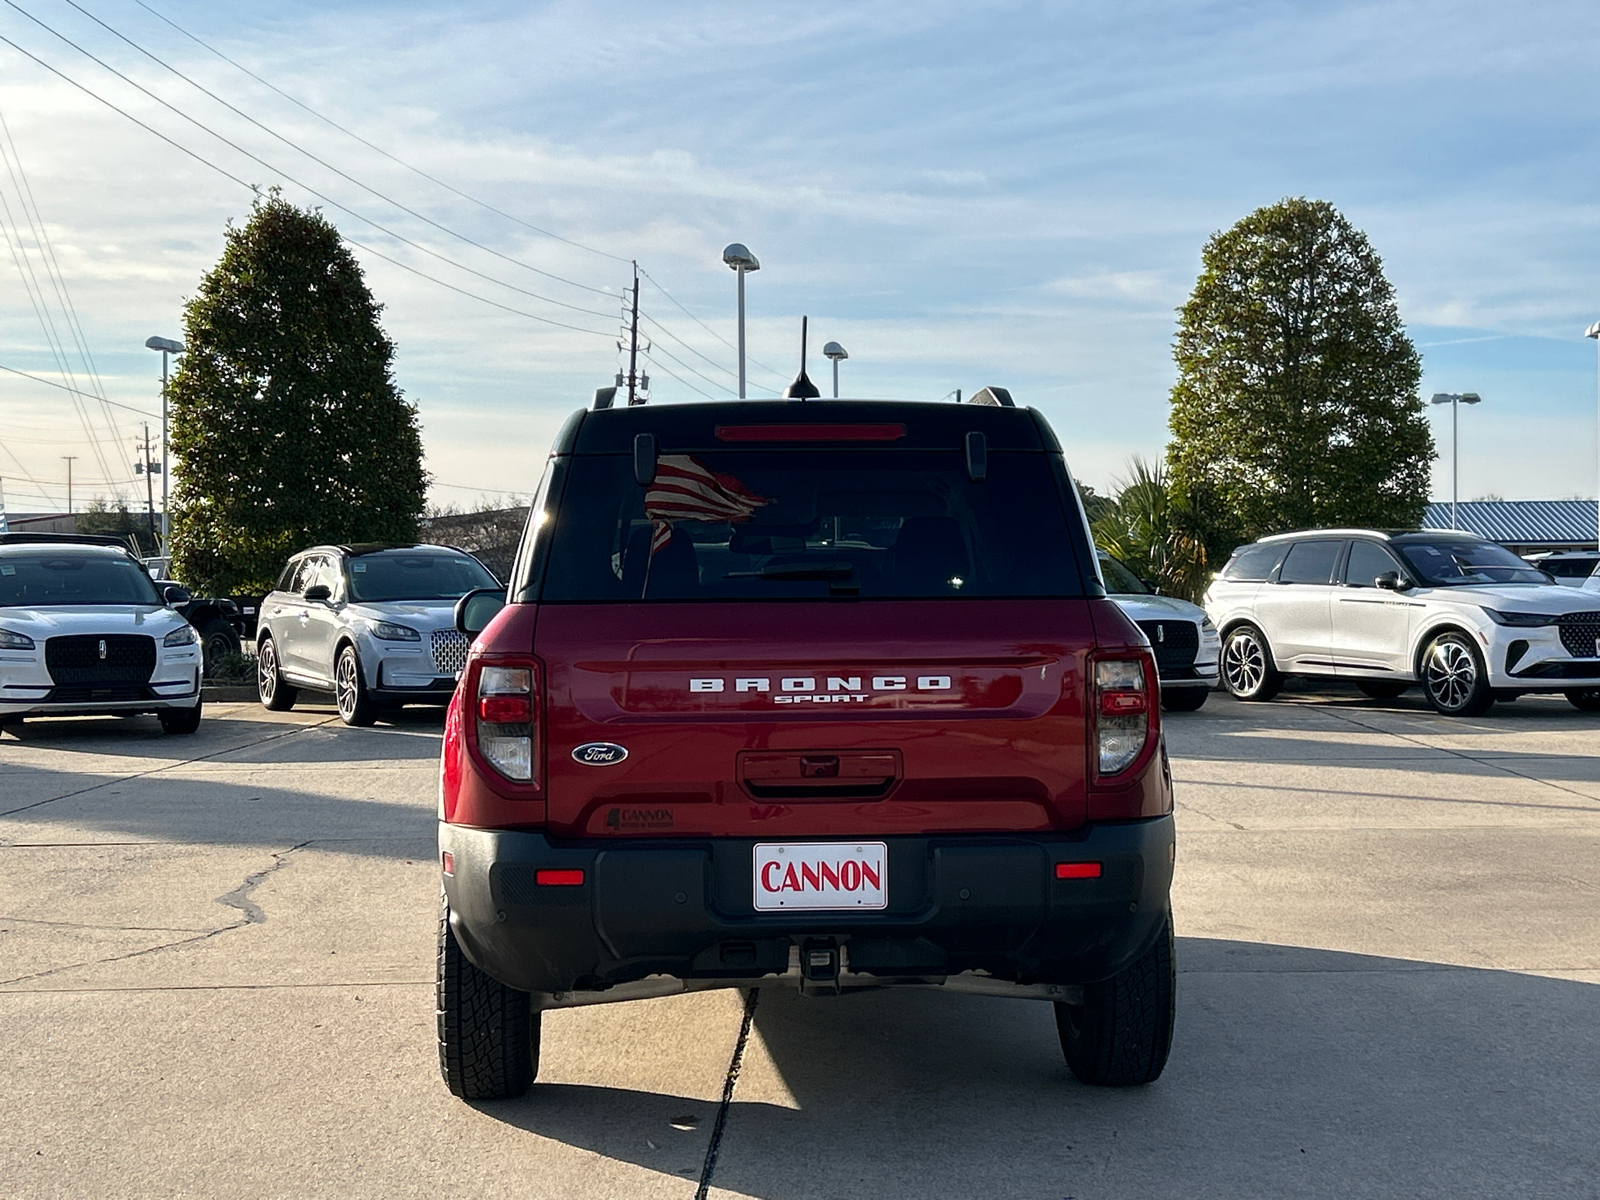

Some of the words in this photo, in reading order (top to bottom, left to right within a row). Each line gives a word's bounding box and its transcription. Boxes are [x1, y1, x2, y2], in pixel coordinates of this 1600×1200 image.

[690, 676, 950, 693] BRONCO
[774, 694, 868, 704] SPORT
[584, 747, 615, 761] Ford
[622, 809, 673, 821] CANNON
[761, 860, 880, 892] CANNON
